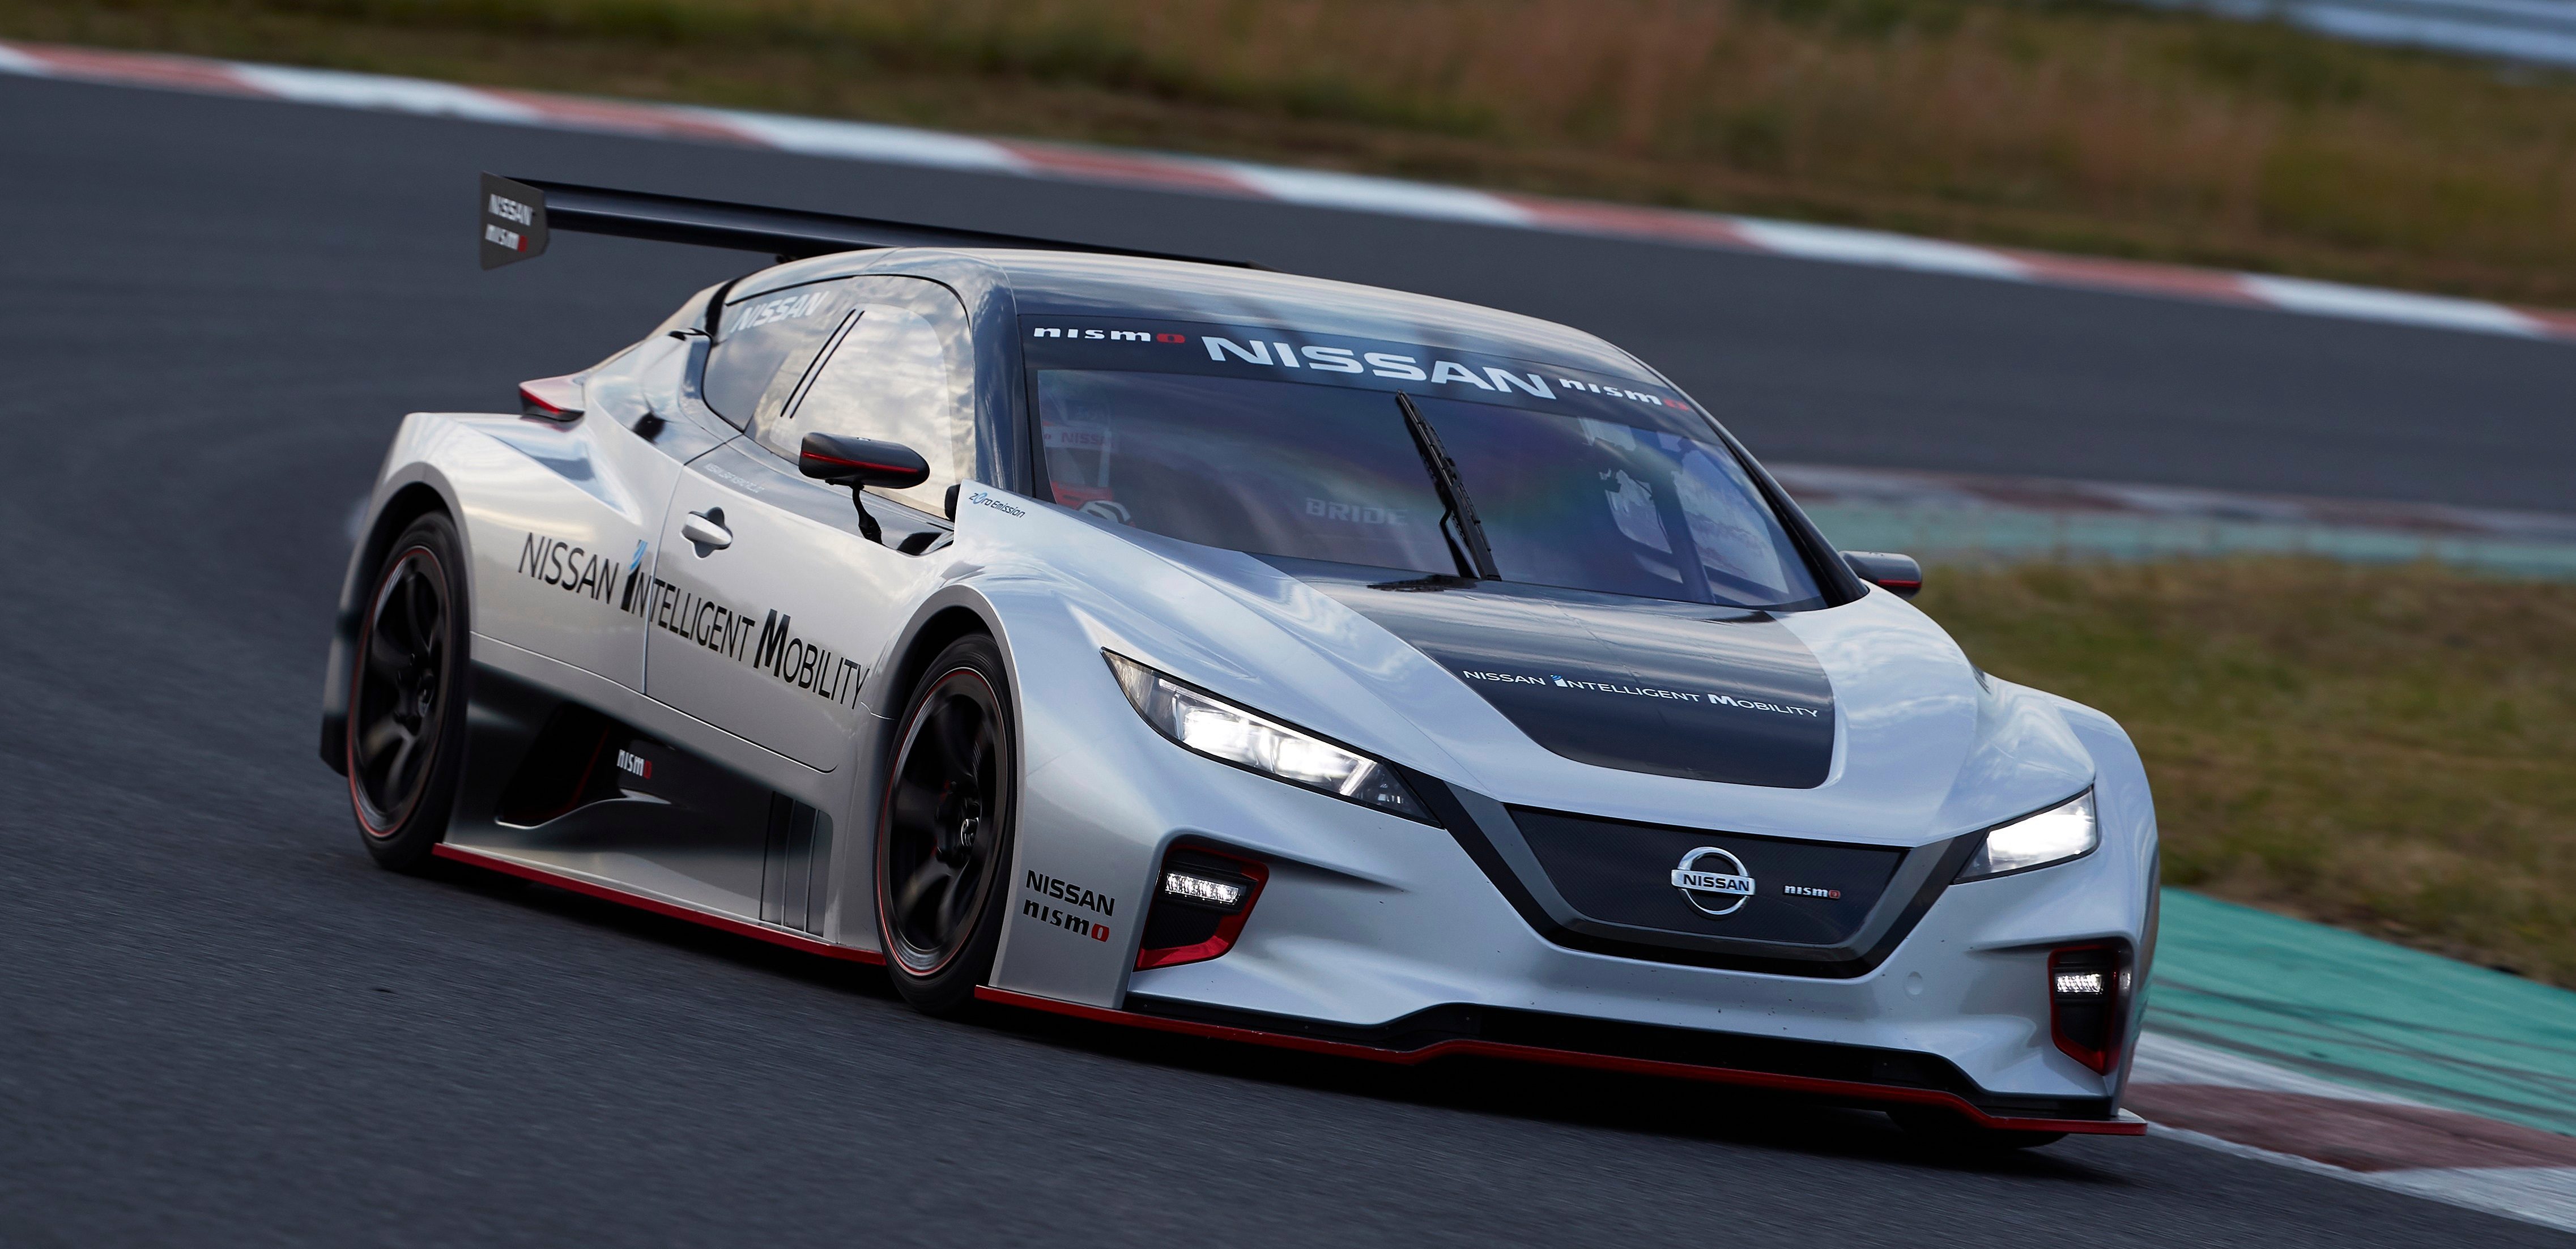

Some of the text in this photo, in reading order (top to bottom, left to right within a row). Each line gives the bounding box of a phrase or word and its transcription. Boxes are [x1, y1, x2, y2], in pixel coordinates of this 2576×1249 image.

[488, 194, 533, 226] NISSAN
[729, 291, 830, 333] NISSAN
[1033, 326, 1689, 412] nismo NISSAN nismo
[991, 501, 1026, 518] Emission
[1305, 497, 1408, 526] BRIDE
[518, 532, 619, 604] NISSAN
[753, 608, 870, 709] MOBILITY
[1463, 670, 1546, 685] NISSAN
[1708, 693, 1819, 717] MOBILITY
[1025, 869, 1115, 916] NISSAN
[1683, 873, 1841, 899] NISSAN nismo
[1023, 899, 1109, 943] nismo
